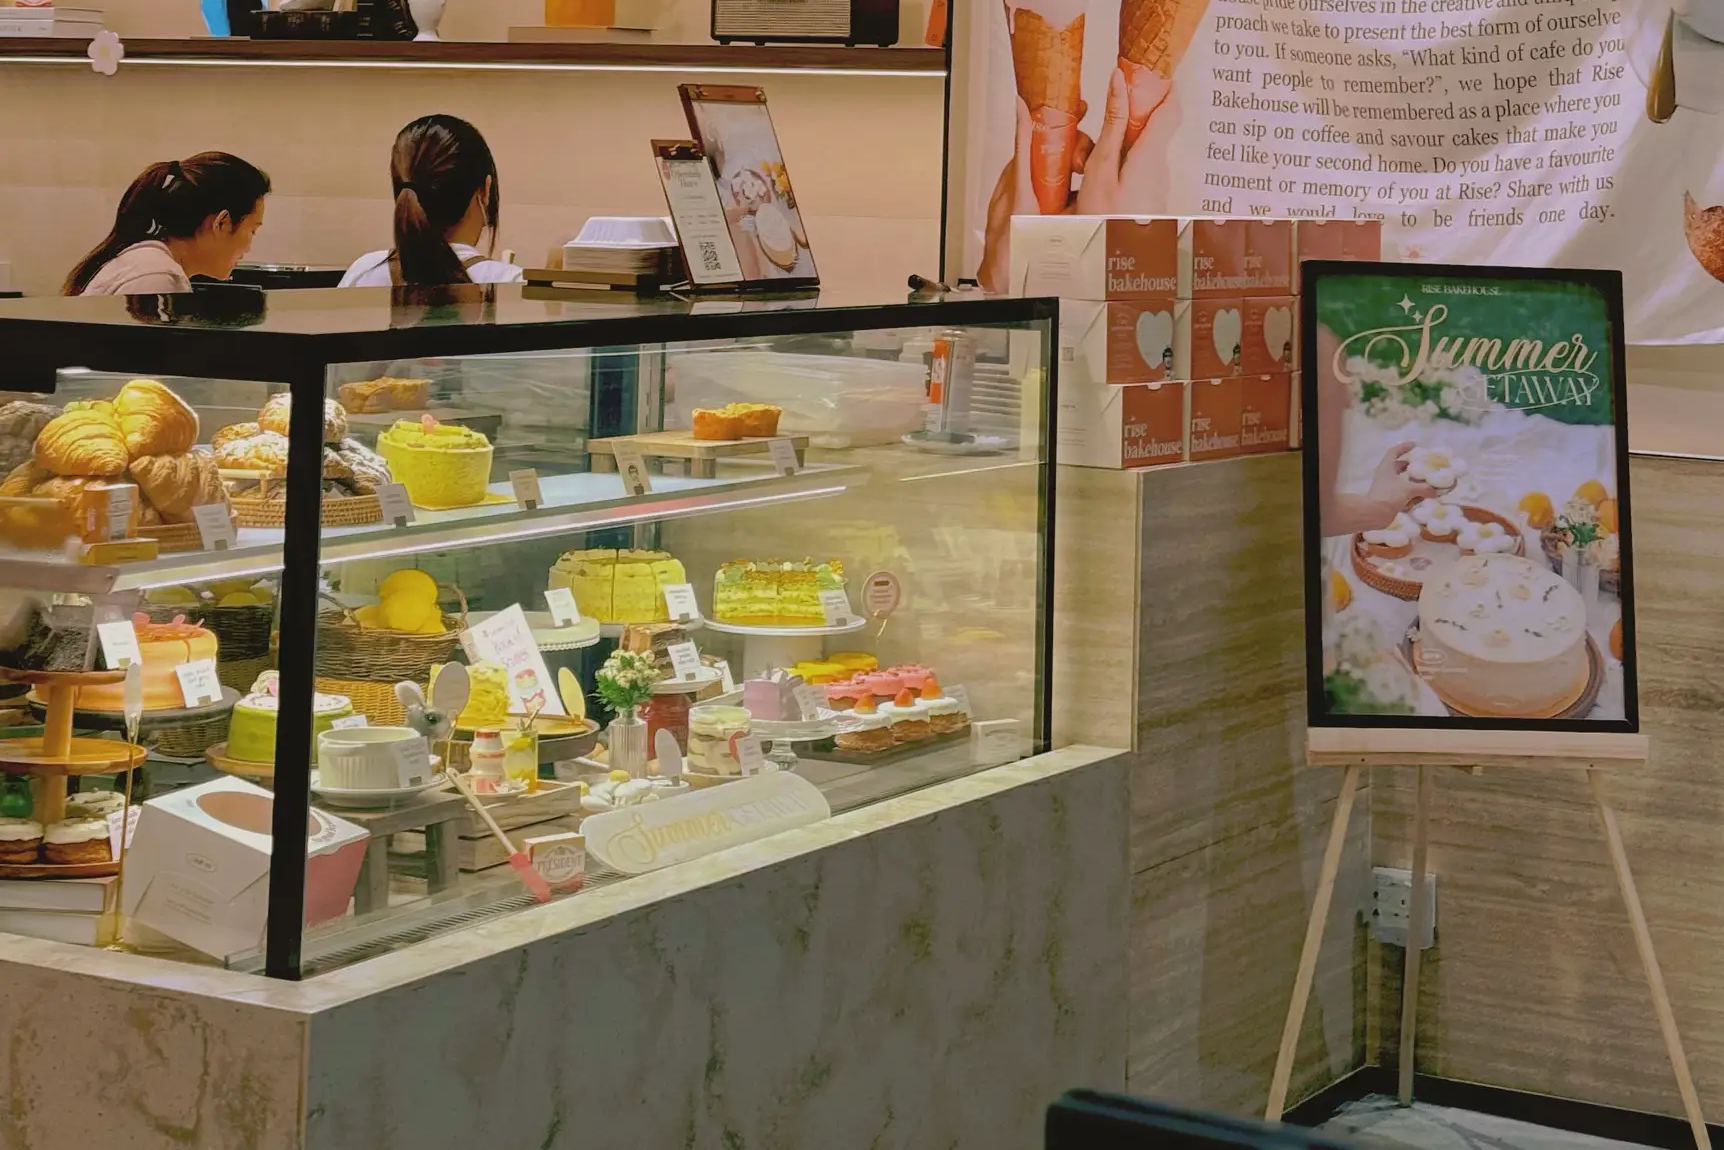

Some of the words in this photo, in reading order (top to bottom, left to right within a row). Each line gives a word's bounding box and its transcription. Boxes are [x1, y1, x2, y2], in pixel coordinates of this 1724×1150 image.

[1212, 68, 1252, 83] want
[1262, 70, 1313, 91] people
[1320, 75, 1334, 90] to
[1458, 79, 1482, 91] we
[1492, 72, 1537, 94] hope
[1548, 67, 1582, 86] that
[1592, 62, 1624, 82] Rise
[1212, 90, 1299, 114] Bakehouse
[1302, 98, 1330, 116] will
[1332, 99, 1350, 118] be
[1352, 102, 1455, 120] remembered
[1459, 106, 1477, 119] as
[1482, 106, 1491, 118] a
[1494, 99, 1540, 122] place
[1544, 95, 1590, 113] where
[1593, 94, 1620, 114] you
[1206, 142, 1236, 161] feel
[1240, 144, 1269, 164] like
[1272, 153, 1312, 170] your
[1316, 154, 1372, 172] second
[1378, 154, 1427, 173] home.
[1432, 157, 1456, 173] Do
[1460, 160, 1489, 177] you
[1494, 154, 1531, 171] have
[1535, 157, 1543, 169] a
[1548, 145, 1614, 168] favourite
[1204, 173, 1272, 191] moment
[1279, 180, 1296, 193] or
[1302, 182, 1372, 202] memory
[1378, 181, 1396, 198] of
[1398, 188, 1428, 204] you
[1436, 185, 1452, 200] at
[1458, 182, 1501, 200] Rise?
[1507, 180, 1552, 198] Share
[1558, 174, 1589, 194] with
[1596, 177, 1613, 190] us
[1108, 254, 1135, 270] rise
[1194, 254, 1214, 270] rise
[1108, 272, 1177, 292] bakehouse
[1422, 284, 1441, 294] RISE
[1444, 284, 1501, 296] BAKEHOUSE
[1332, 304, 1598, 386] Summer
[1124, 421, 1148, 438] rise
[1124, 437, 1183, 460] bakehouse
